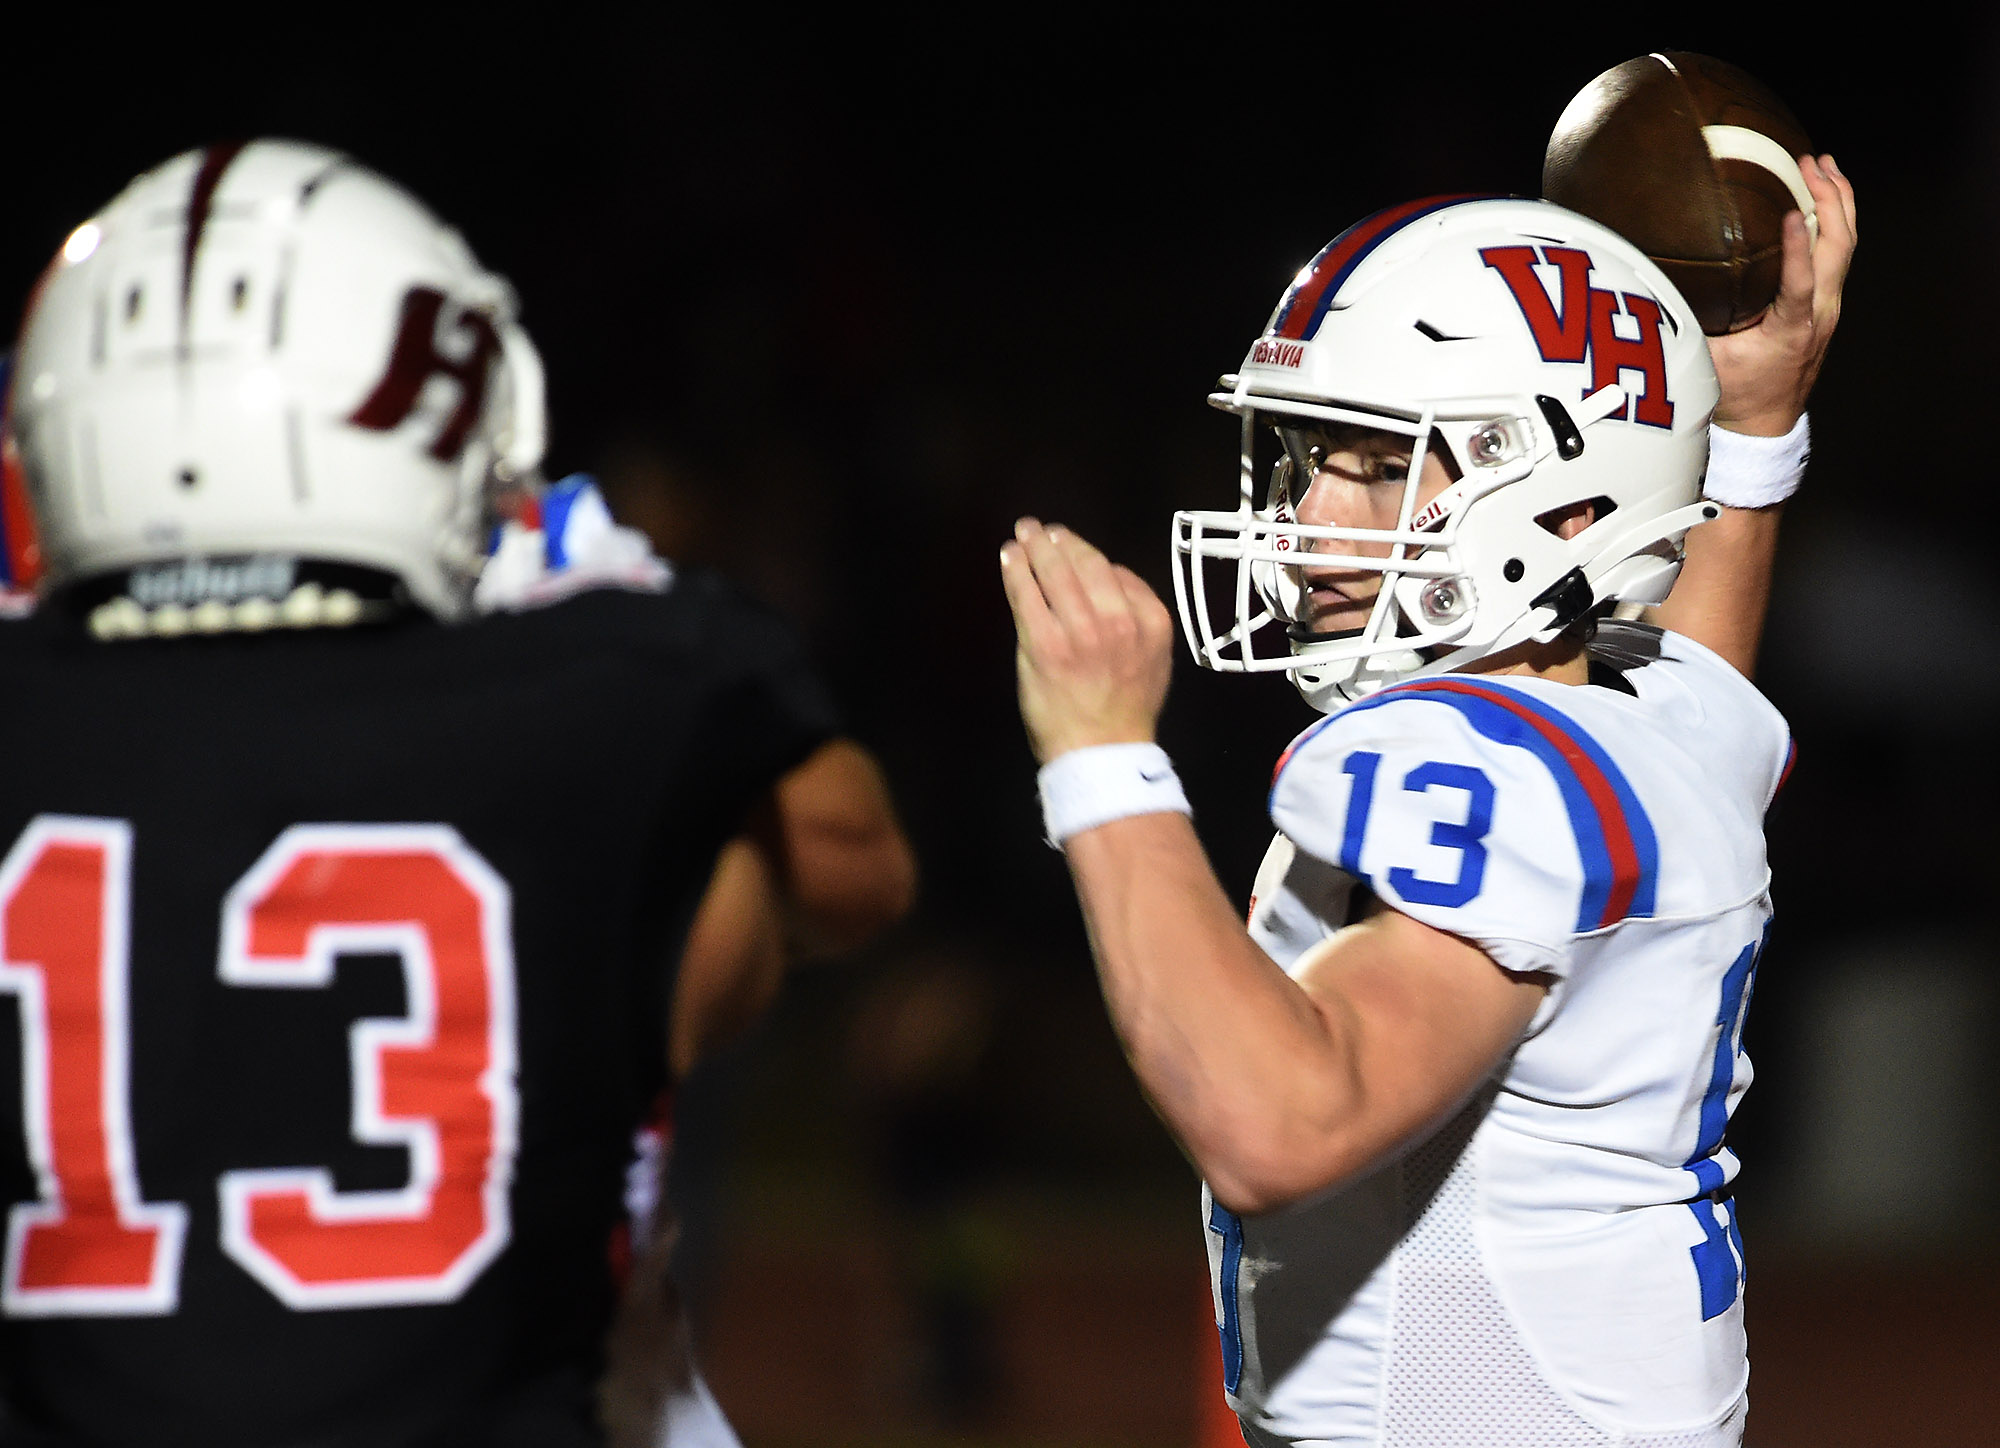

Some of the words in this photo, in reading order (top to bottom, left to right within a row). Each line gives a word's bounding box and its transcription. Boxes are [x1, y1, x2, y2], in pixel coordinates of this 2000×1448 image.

[345, 285, 505, 463] H
[1252, 342, 1304, 368] VESTAVIA
[1477, 245, 1674, 430] VH
[1341, 751, 1497, 910] 13
[0, 814, 520, 1318] 13
[1684, 917, 1772, 1322] 1
